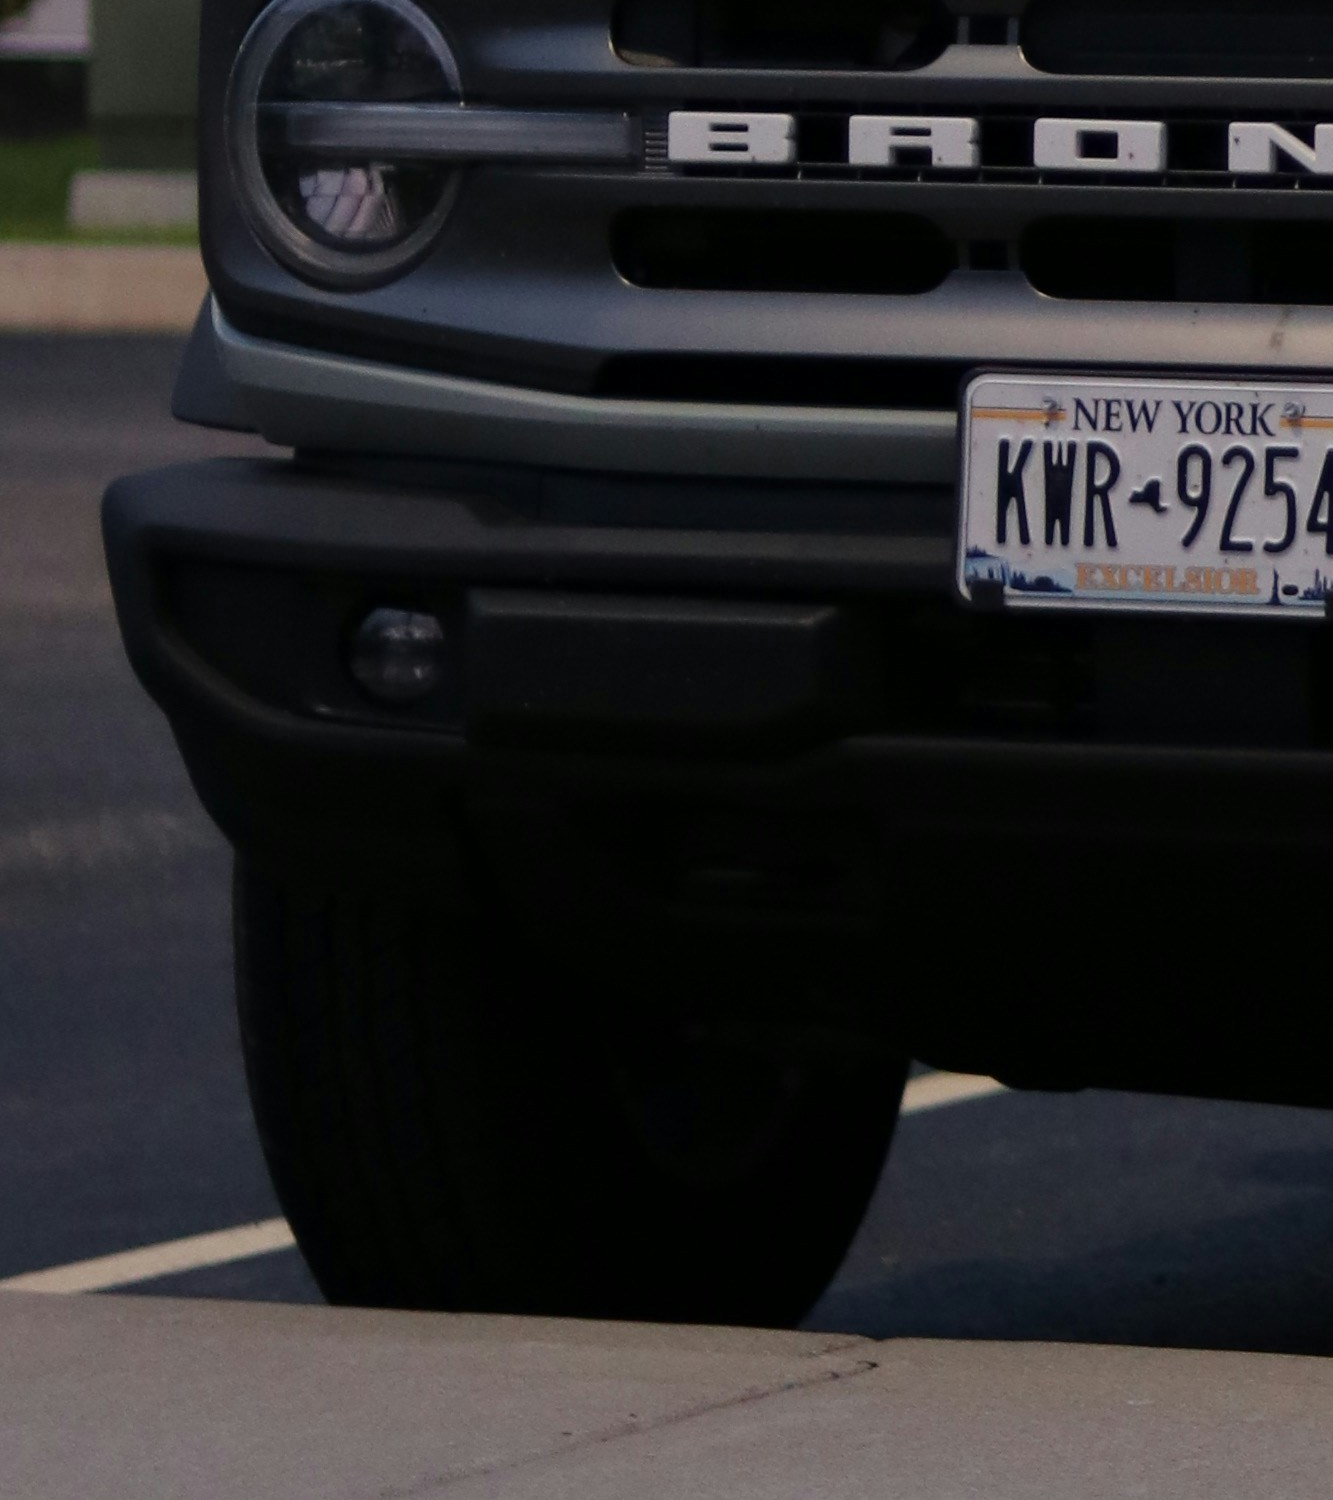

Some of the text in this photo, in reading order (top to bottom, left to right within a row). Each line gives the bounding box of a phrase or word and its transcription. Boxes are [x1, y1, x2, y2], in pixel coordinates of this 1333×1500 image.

[1072, 396, 1277, 437] NEW YORK
[996, 437, 1122, 548] KWR
[1075, 562, 1261, 596] EXCELSIOR
